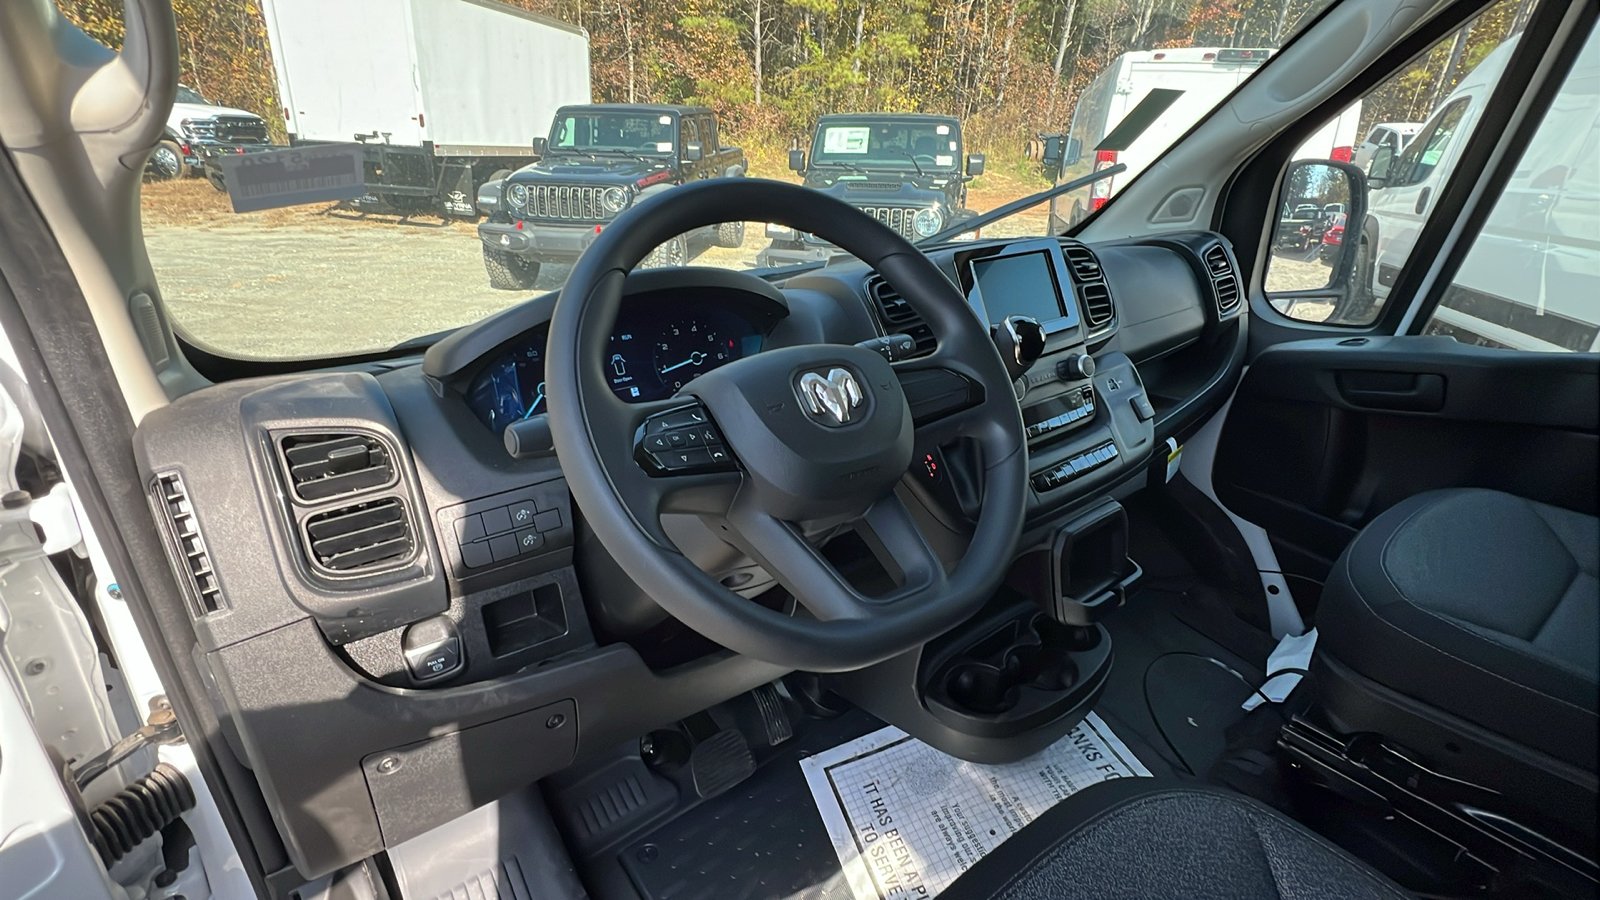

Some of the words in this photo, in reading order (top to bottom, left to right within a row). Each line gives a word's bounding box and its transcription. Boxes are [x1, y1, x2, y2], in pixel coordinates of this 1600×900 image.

[1039, 770, 1054, 789] WITH
[1045, 765, 1061, 784] YOUR
[863, 782, 880, 794] IT
[990, 777, 1000, 789] the
[997, 790, 1012, 809] most
[870, 798, 893, 826] HAS
[952, 803, 966, 820] Your
[994, 803, 1004, 815] the
[931, 810, 942, 823] are
[938, 823, 957, 851] always
[884, 828, 912, 868] BEEN
[961, 843, 974, 856] our
[861, 823, 879, 843] TO
[871, 845, 904, 896] SERVE
[904, 871, 919, 883] A
